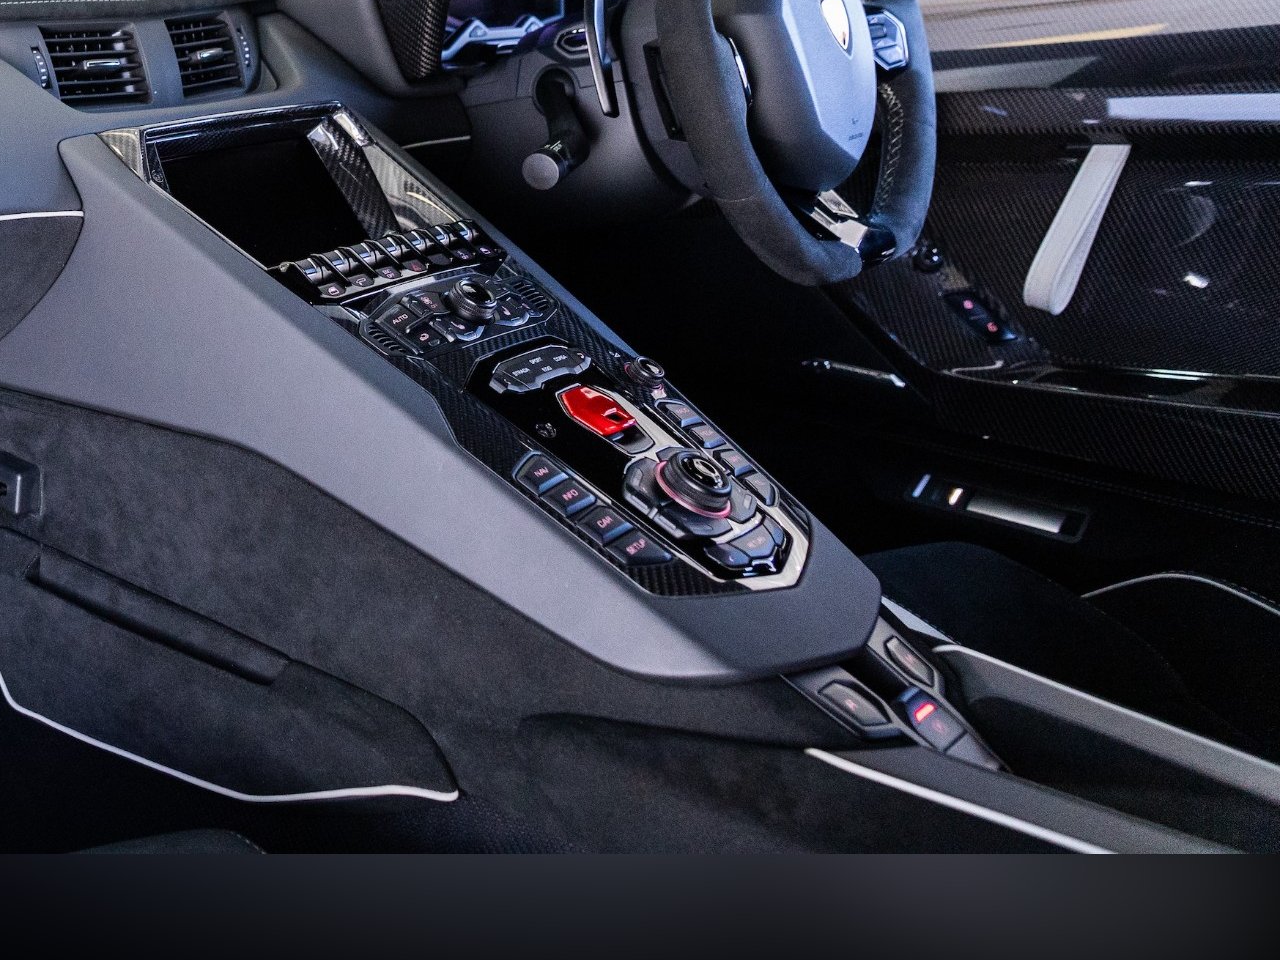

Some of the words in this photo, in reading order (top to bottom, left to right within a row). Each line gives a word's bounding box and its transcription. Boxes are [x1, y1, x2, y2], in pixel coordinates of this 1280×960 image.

[392, 313, 409, 325] AUTO
[533, 466, 549, 478] NAV
[562, 488, 579, 501] INFO
[596, 515, 613, 529] CAR
[625, 538, 646, 556] SETUP
